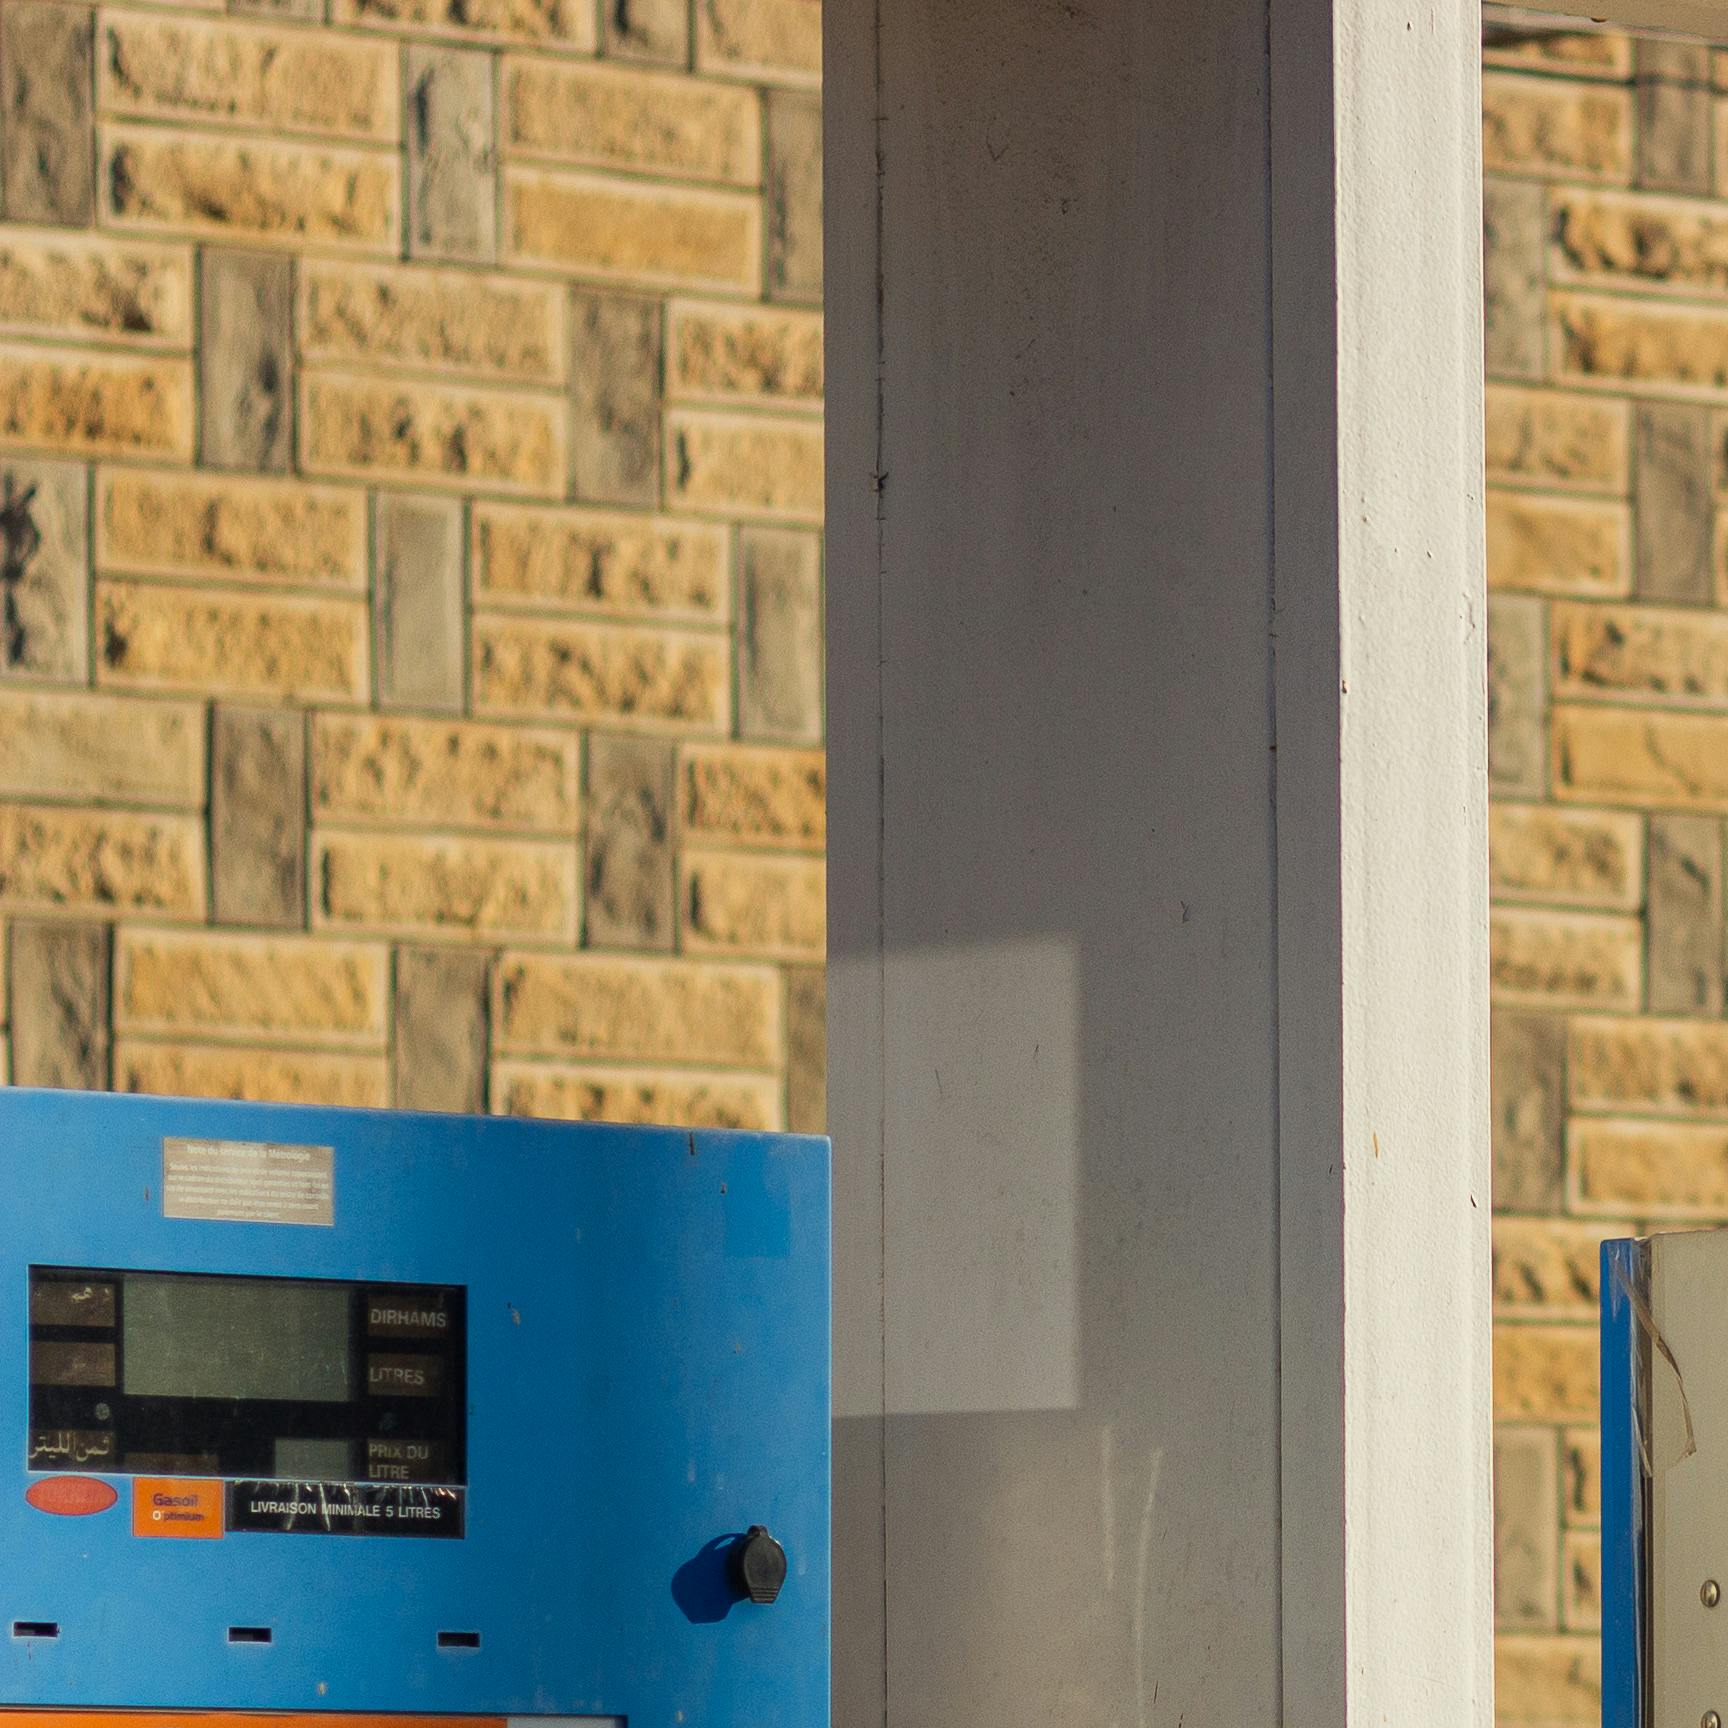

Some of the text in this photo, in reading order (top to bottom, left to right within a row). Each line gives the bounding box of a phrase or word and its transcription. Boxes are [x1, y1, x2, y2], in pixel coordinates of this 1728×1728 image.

[369, 1309, 447, 1329] DIRHAMS
[369, 1367, 425, 1386] LITRES
[368, 1443, 430, 1461] PRIX DU
[368, 1463, 410, 1480] LITRE
[152, 1492, 200, 1508] Gasoil
[250, 1500, 441, 1519] LIVRAISON MINIMALE 5 LITRES
